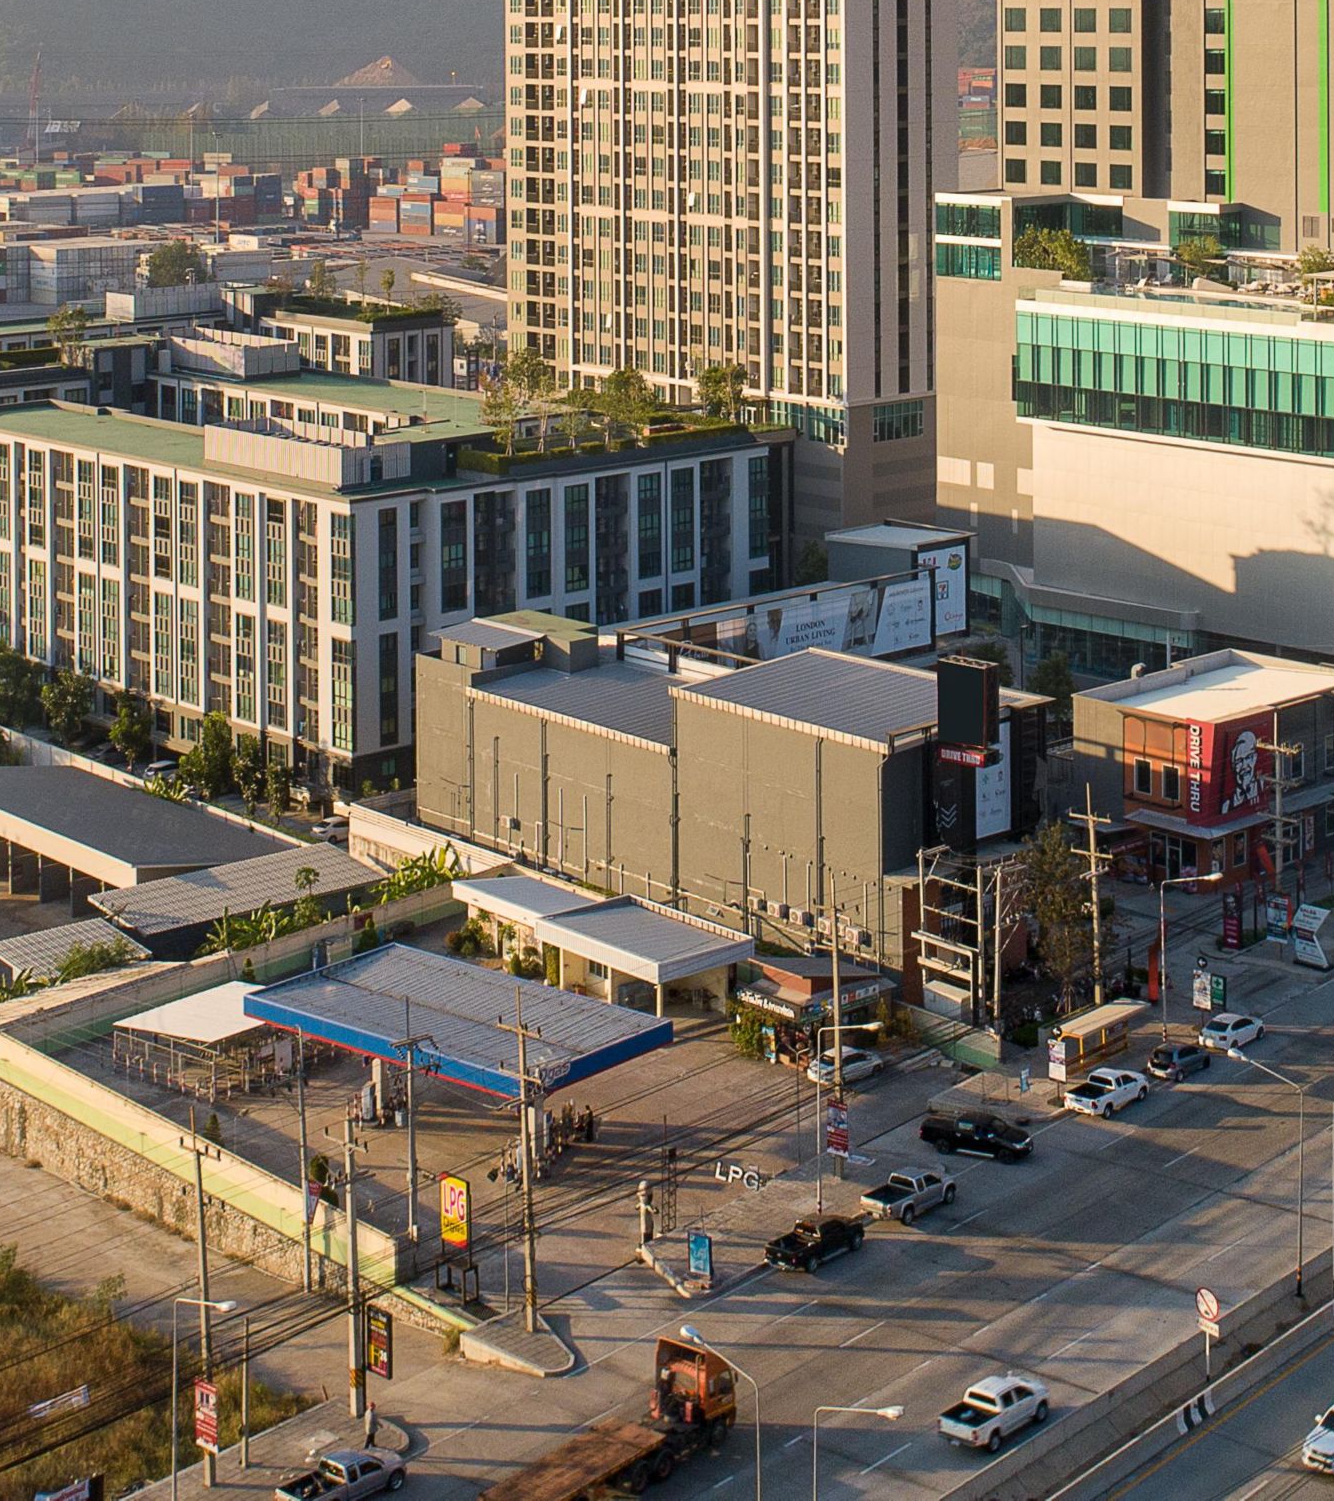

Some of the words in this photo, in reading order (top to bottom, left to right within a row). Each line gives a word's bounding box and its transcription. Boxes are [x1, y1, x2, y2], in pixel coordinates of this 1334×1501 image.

[785, 633, 810, 644] URBAN
[811, 628, 836, 639] LIVING
[796, 620, 825, 632] LONDON
[941, 749, 962, 762] DRIVE
[1190, 724, 1200, 769] DRIVE
[1190, 771, 1200, 813] THRU
[715, 1161, 761, 1191] LPG
[443, 1182, 465, 1221] LPG
